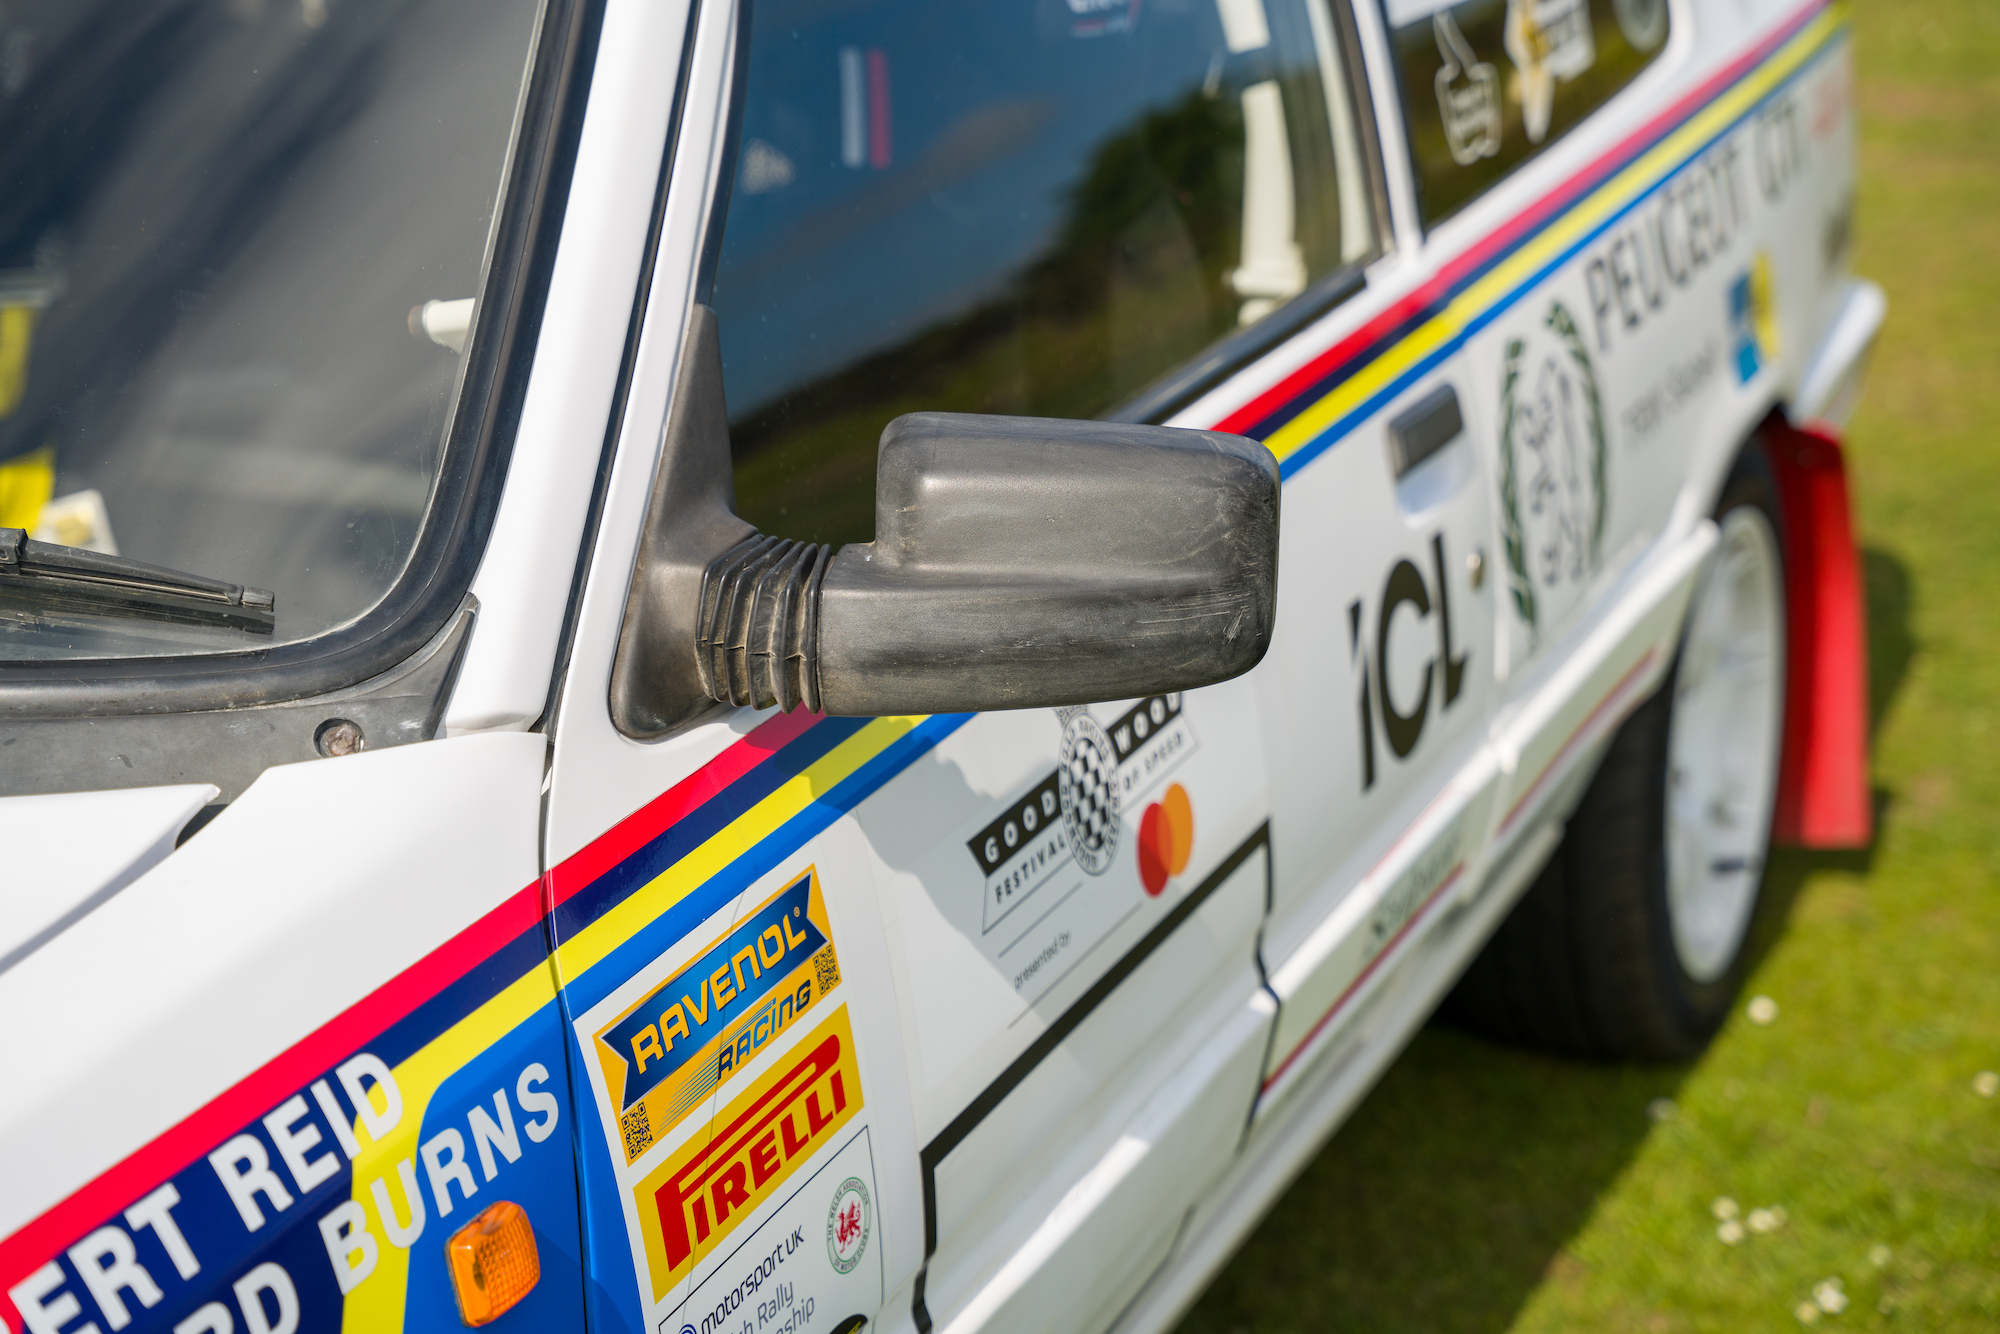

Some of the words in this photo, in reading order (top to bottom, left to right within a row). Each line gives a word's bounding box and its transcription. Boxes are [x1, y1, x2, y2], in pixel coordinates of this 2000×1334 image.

[1347, 531, 1469, 795] ICL
[984, 788, 1058, 864] GOOD
[1113, 692, 1181, 755] WOOD
[995, 833, 1066, 904] FESTIVAL
[1014, 935, 1058, 993] presented
[1058, 930, 1070, 948] by
[0, 1182, 201, 1334] ERT
[207, 1052, 404, 1233] REID
[317, 1062, 559, 1297] BURNS
[654, 1034, 847, 1273] PIRELLI
[701, 1243, 785, 1334] motorsport
[785, 1224, 805, 1256] UK
[757, 1281, 794, 1330] Rally
[775, 1296, 815, 1334] ship
